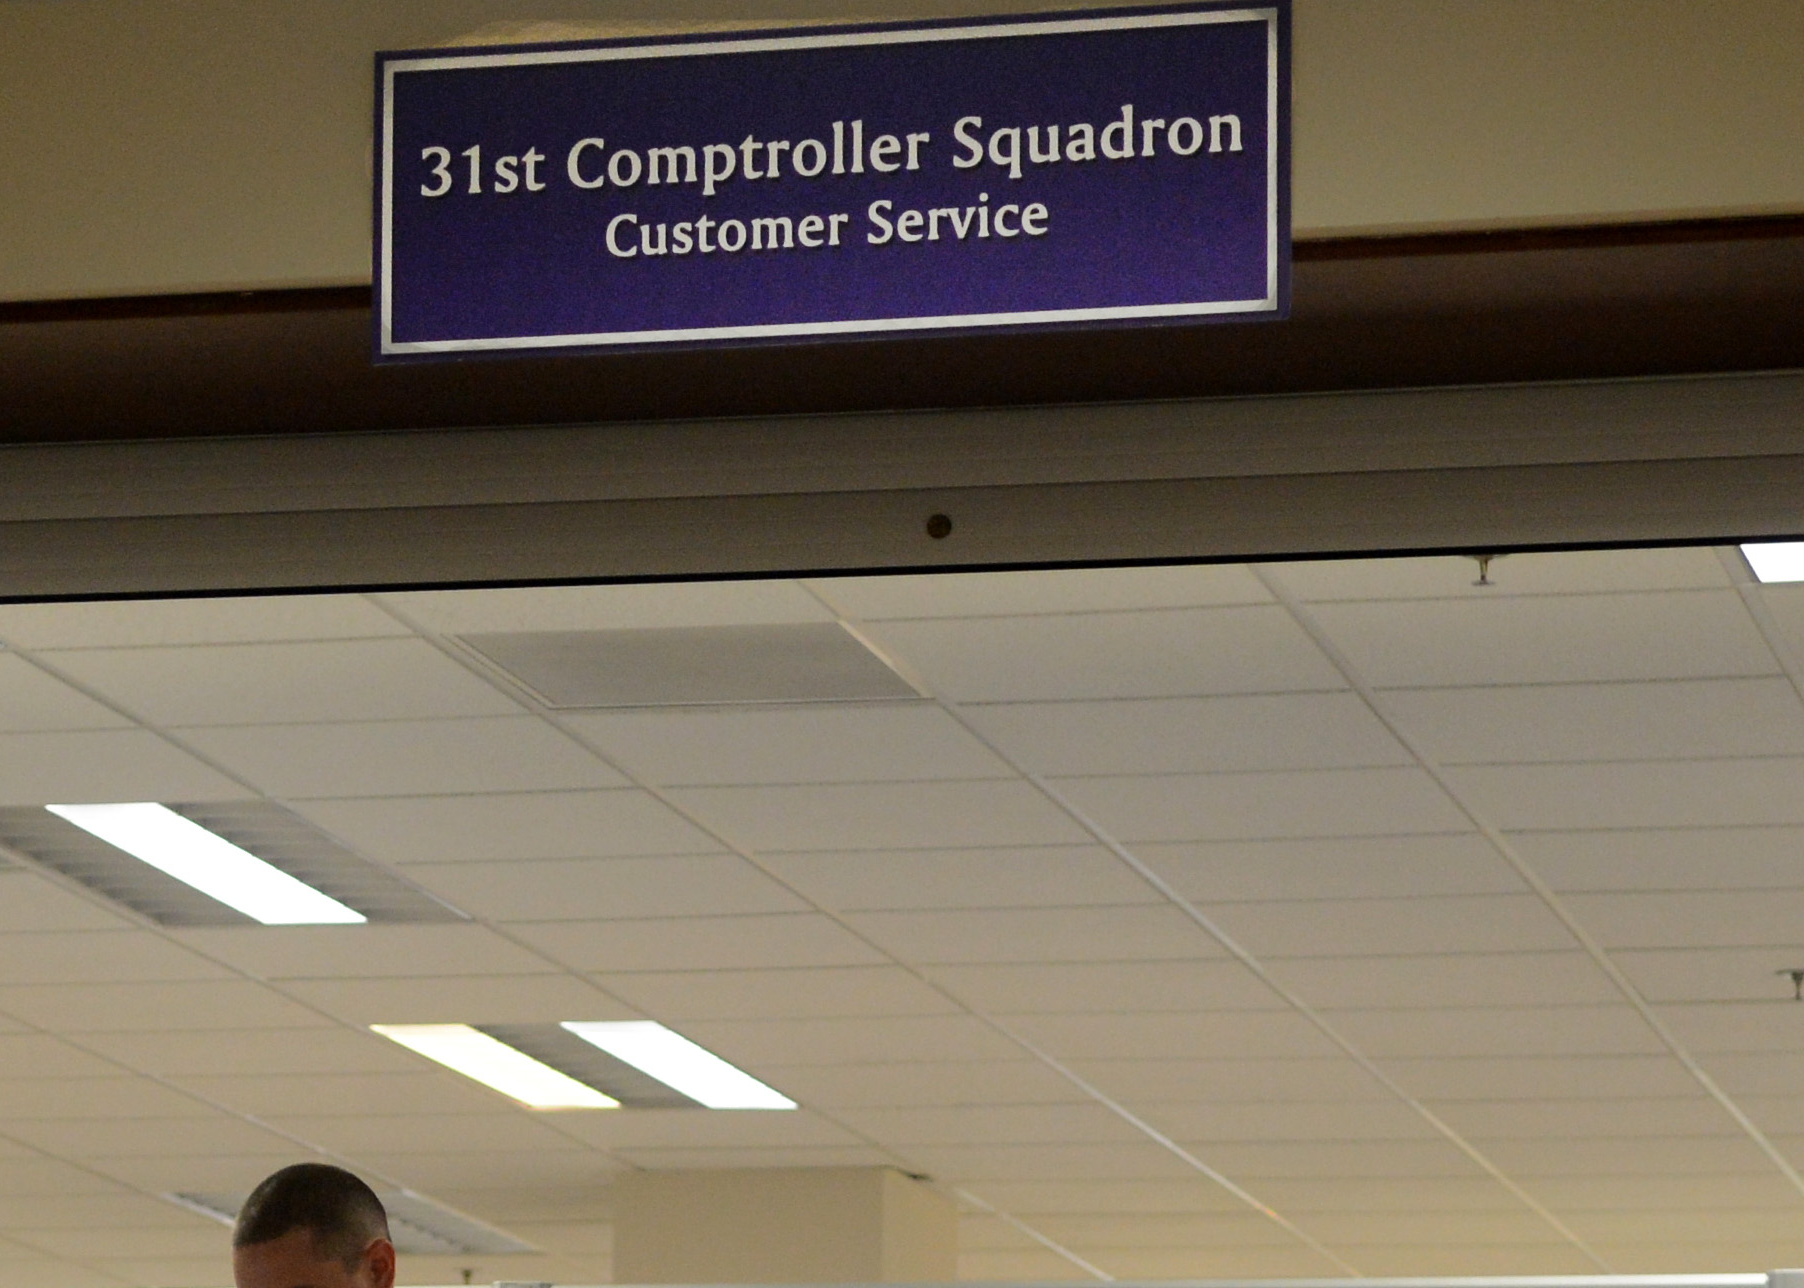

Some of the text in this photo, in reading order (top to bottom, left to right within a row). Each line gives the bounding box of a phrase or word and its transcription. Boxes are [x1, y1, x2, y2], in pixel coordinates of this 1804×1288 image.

[420, 103, 1243, 197] 31st Comptroller Squadron
[605, 192, 1049, 258] Customer Service
